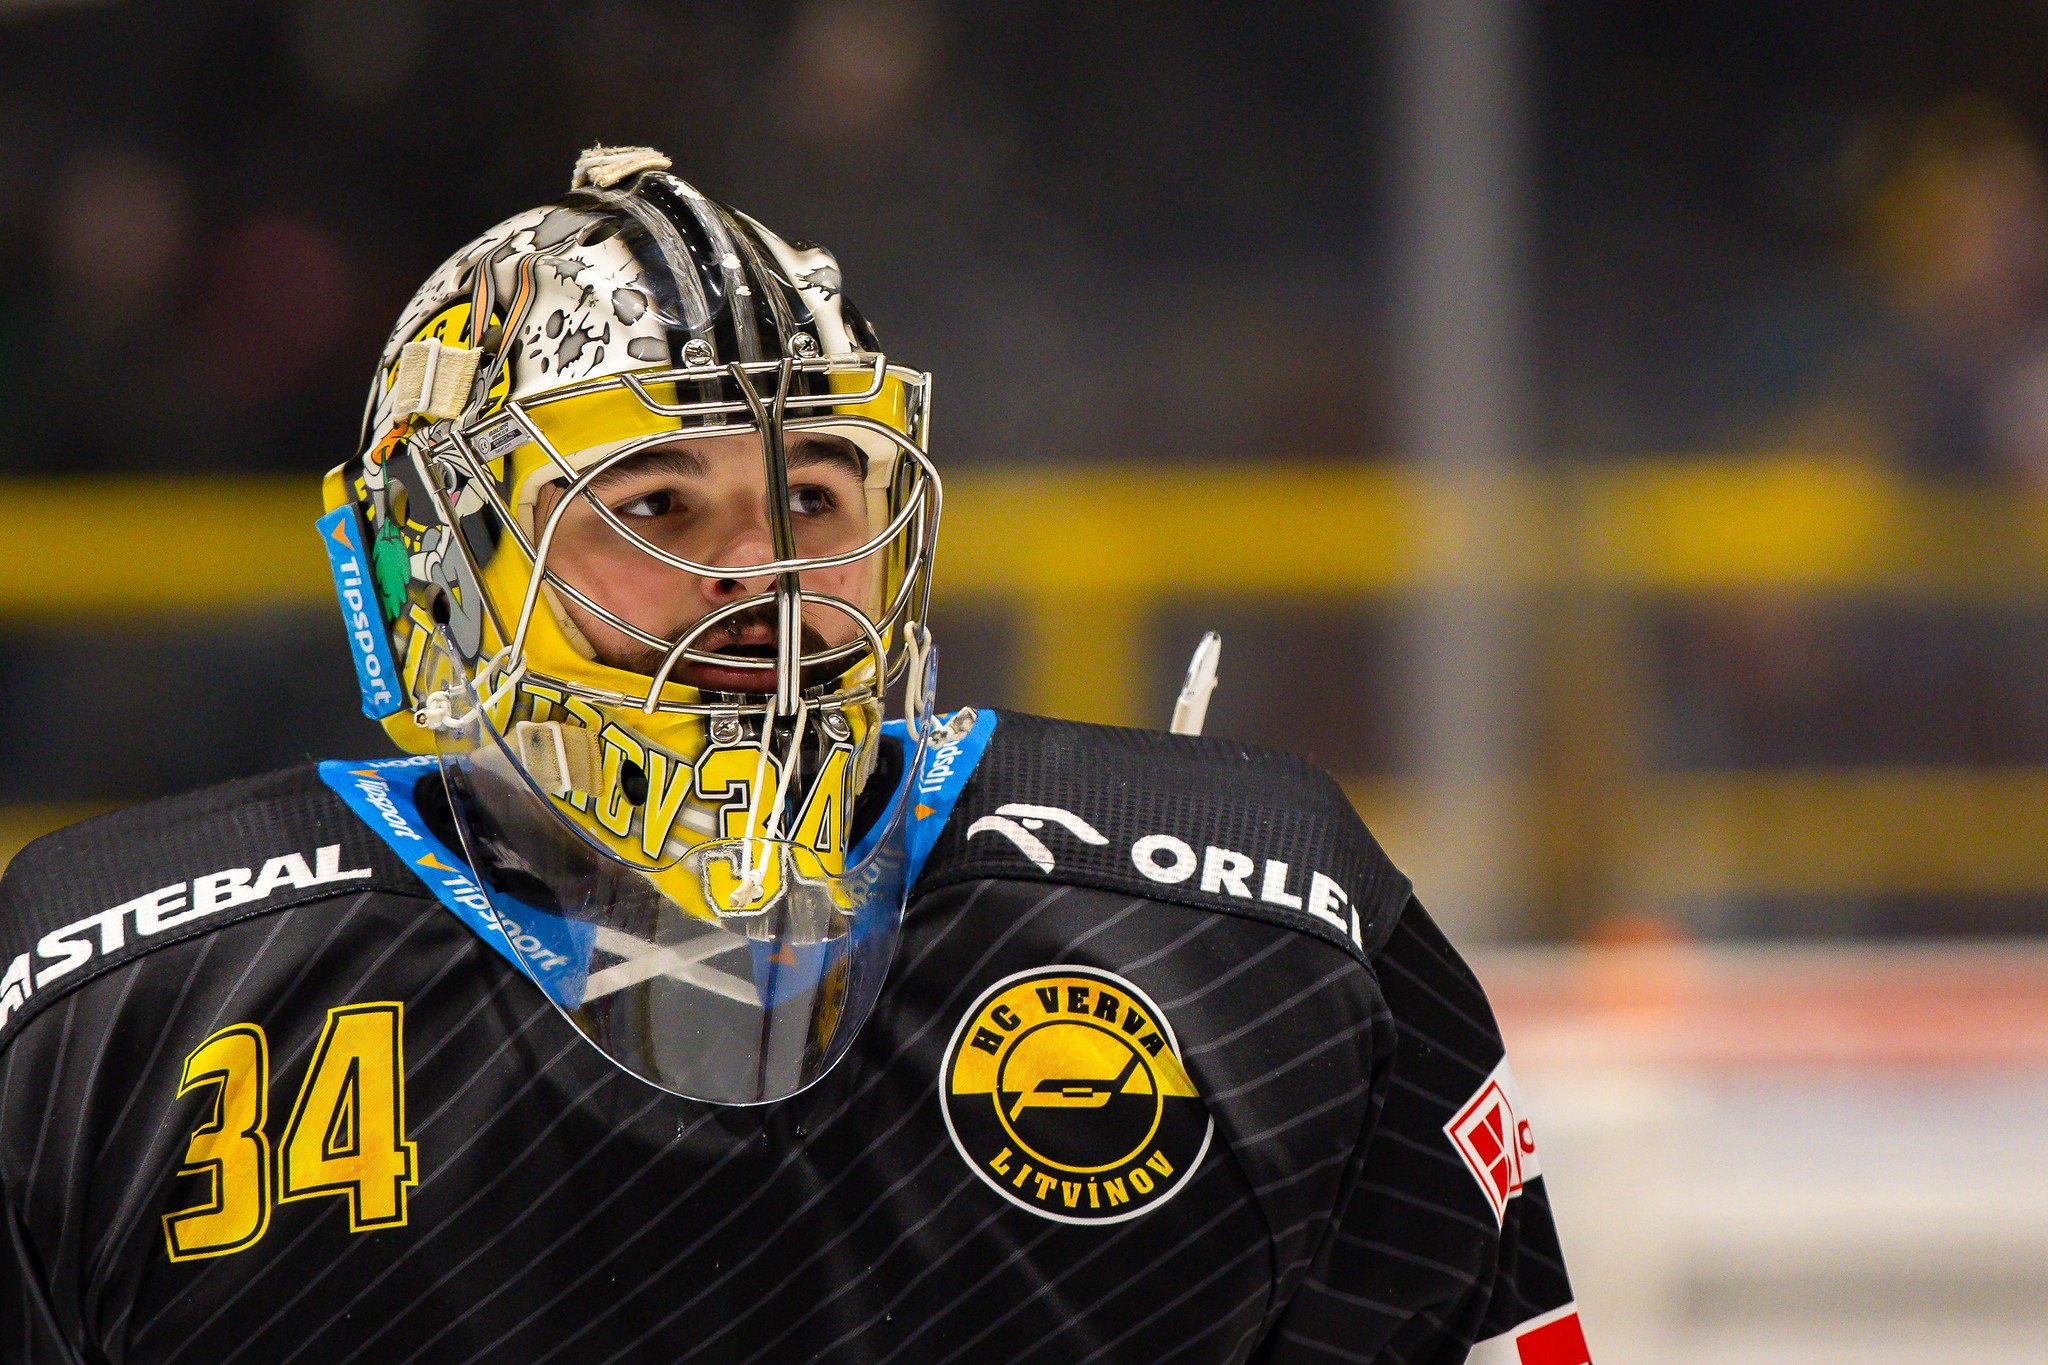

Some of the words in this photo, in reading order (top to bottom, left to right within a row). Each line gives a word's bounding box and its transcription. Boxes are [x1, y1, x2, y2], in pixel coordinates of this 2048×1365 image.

[340, 556, 392, 706] Tipsport
[355, 778, 423, 841] Tipsport
[694, 741, 855, 917] 34
[0, 843, 372, 1031] ASTEBAL
[442, 875, 569, 972] Tipsport
[970, 1004, 1022, 1056] HC
[1035, 986, 1165, 1057] VERVA
[162, 1001, 418, 1262] 34
[989, 1147, 1174, 1208] LITVÍNOV
